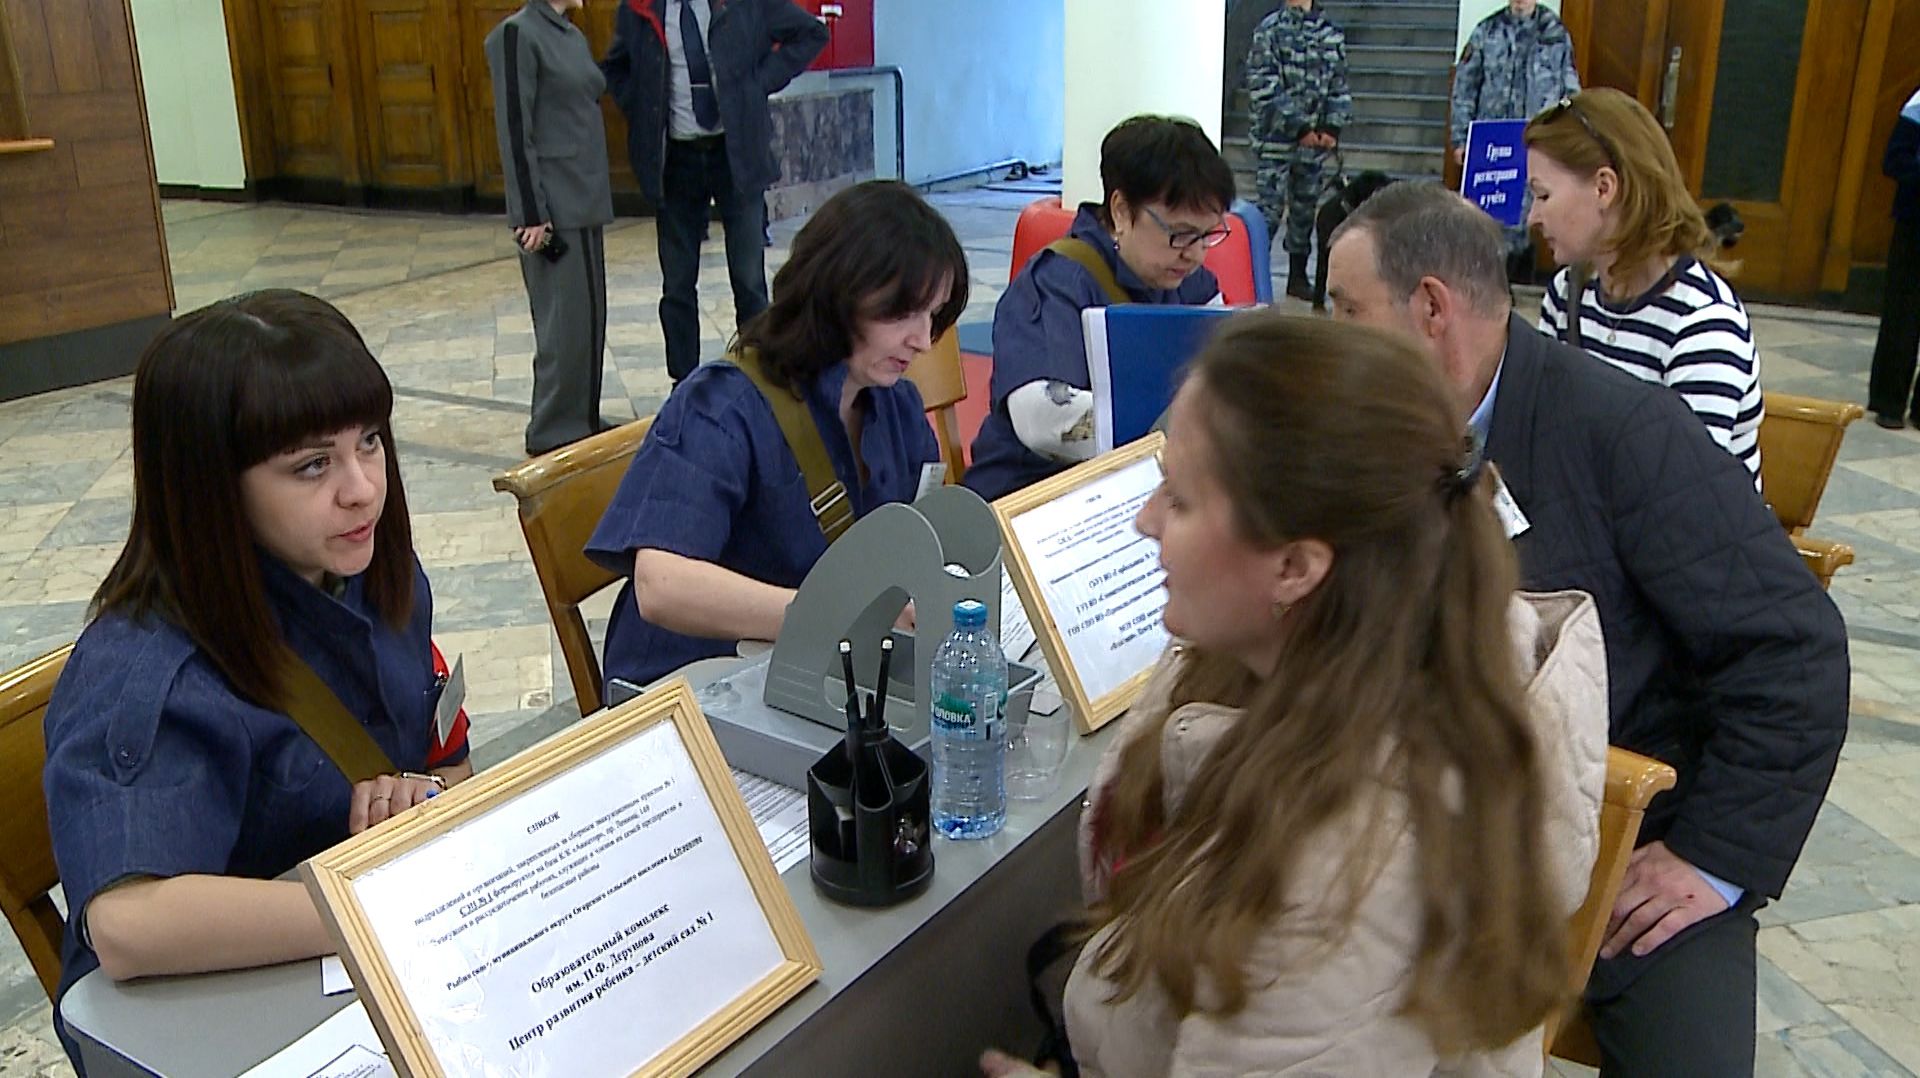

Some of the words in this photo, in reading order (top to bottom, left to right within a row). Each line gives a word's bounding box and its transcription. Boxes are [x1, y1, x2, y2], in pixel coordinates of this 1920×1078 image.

[1486, 142, 1513, 162] Группа
[1473, 168, 1519, 187] регистрации
[1479, 194, 1486, 205] и
[526, 811, 561, 835] СПИСОК
[531, 930, 624, 994] Образовательный
[623, 903, 670, 937] комплекс
[565, 979, 585, 995] им.
[583, 962, 610, 983] П.Ф.
[609, 932, 655, 969] Дерунова
[508, 1023, 545, 1051] Центр
[545, 991, 595, 1031] развития
[594, 965, 635, 999] ребенка
[641, 933, 680, 967] детский
[679, 924, 697, 940] сад
[695, 916, 708, 930] №
